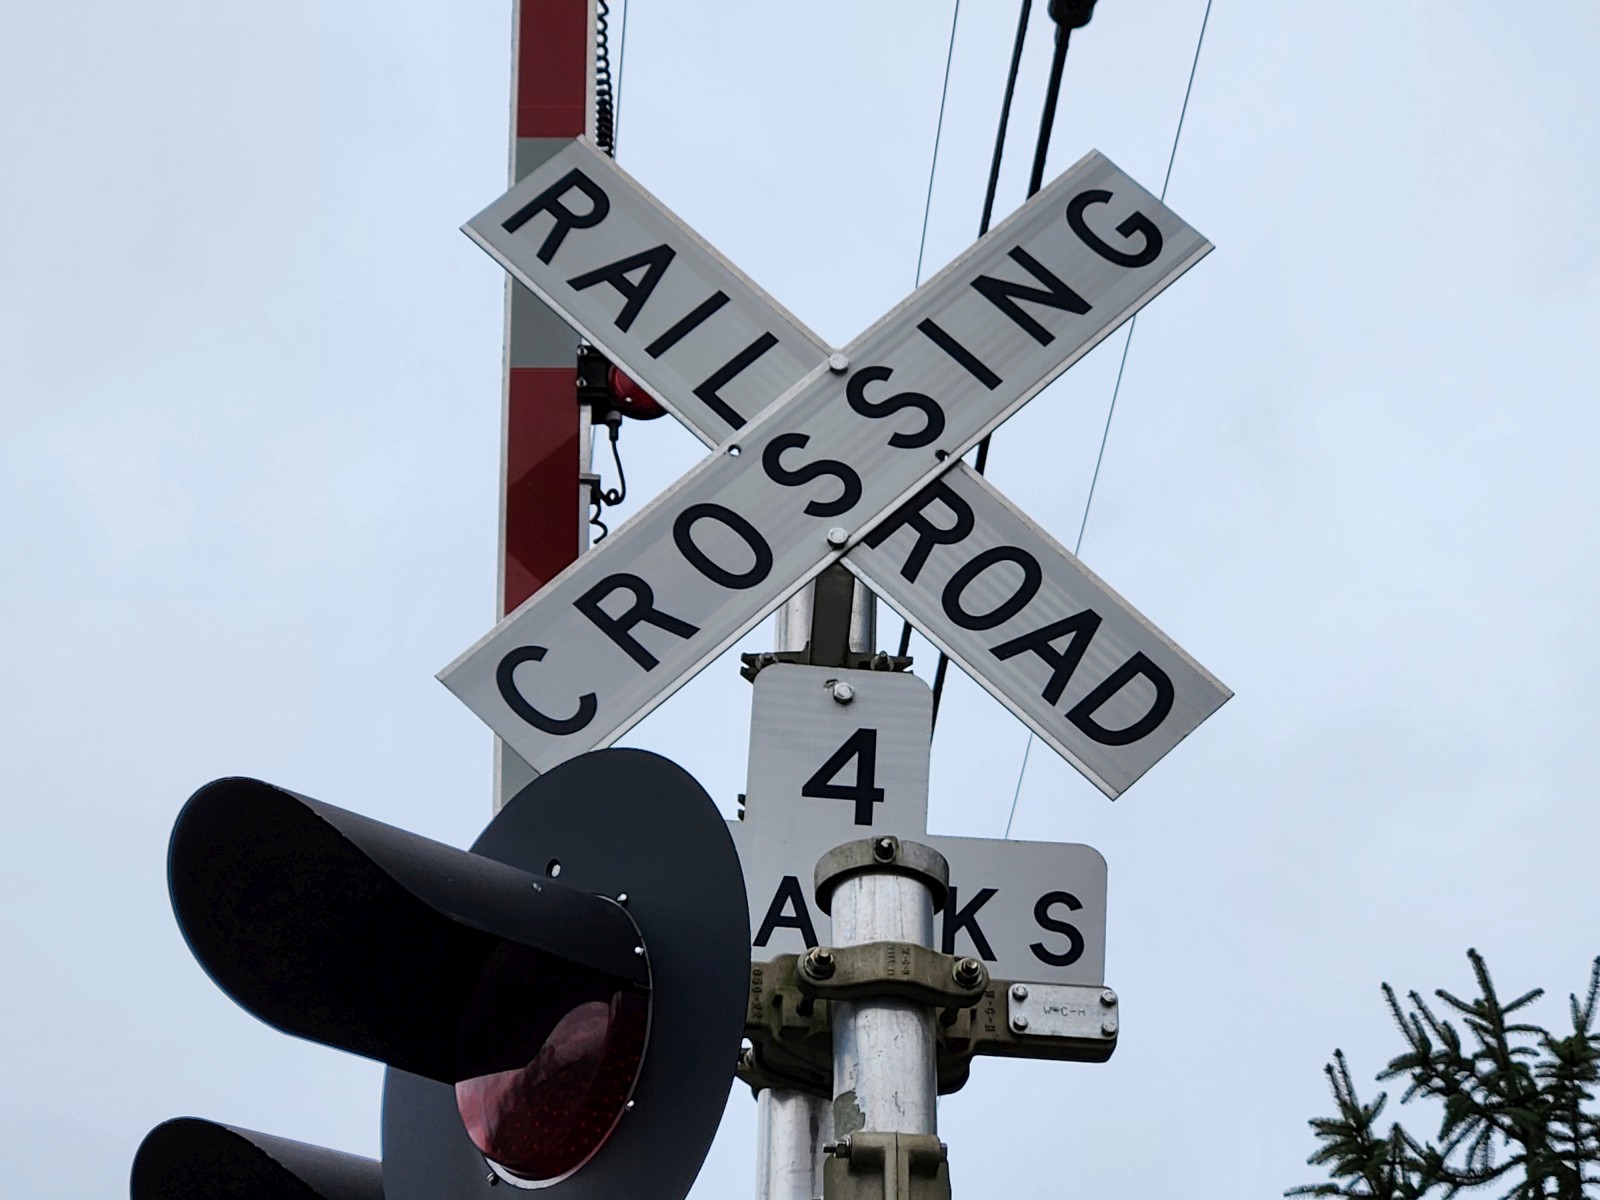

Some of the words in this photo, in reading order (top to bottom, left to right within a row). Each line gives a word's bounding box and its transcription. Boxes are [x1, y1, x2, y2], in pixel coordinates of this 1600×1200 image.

[495, 189, 1163, 736] CROSSING
[501, 167, 779, 431] RAIL
[862, 479, 1175, 746] ROAD
[752, 875, 1085, 967] AKS
[801, 727, 885, 826] 4
